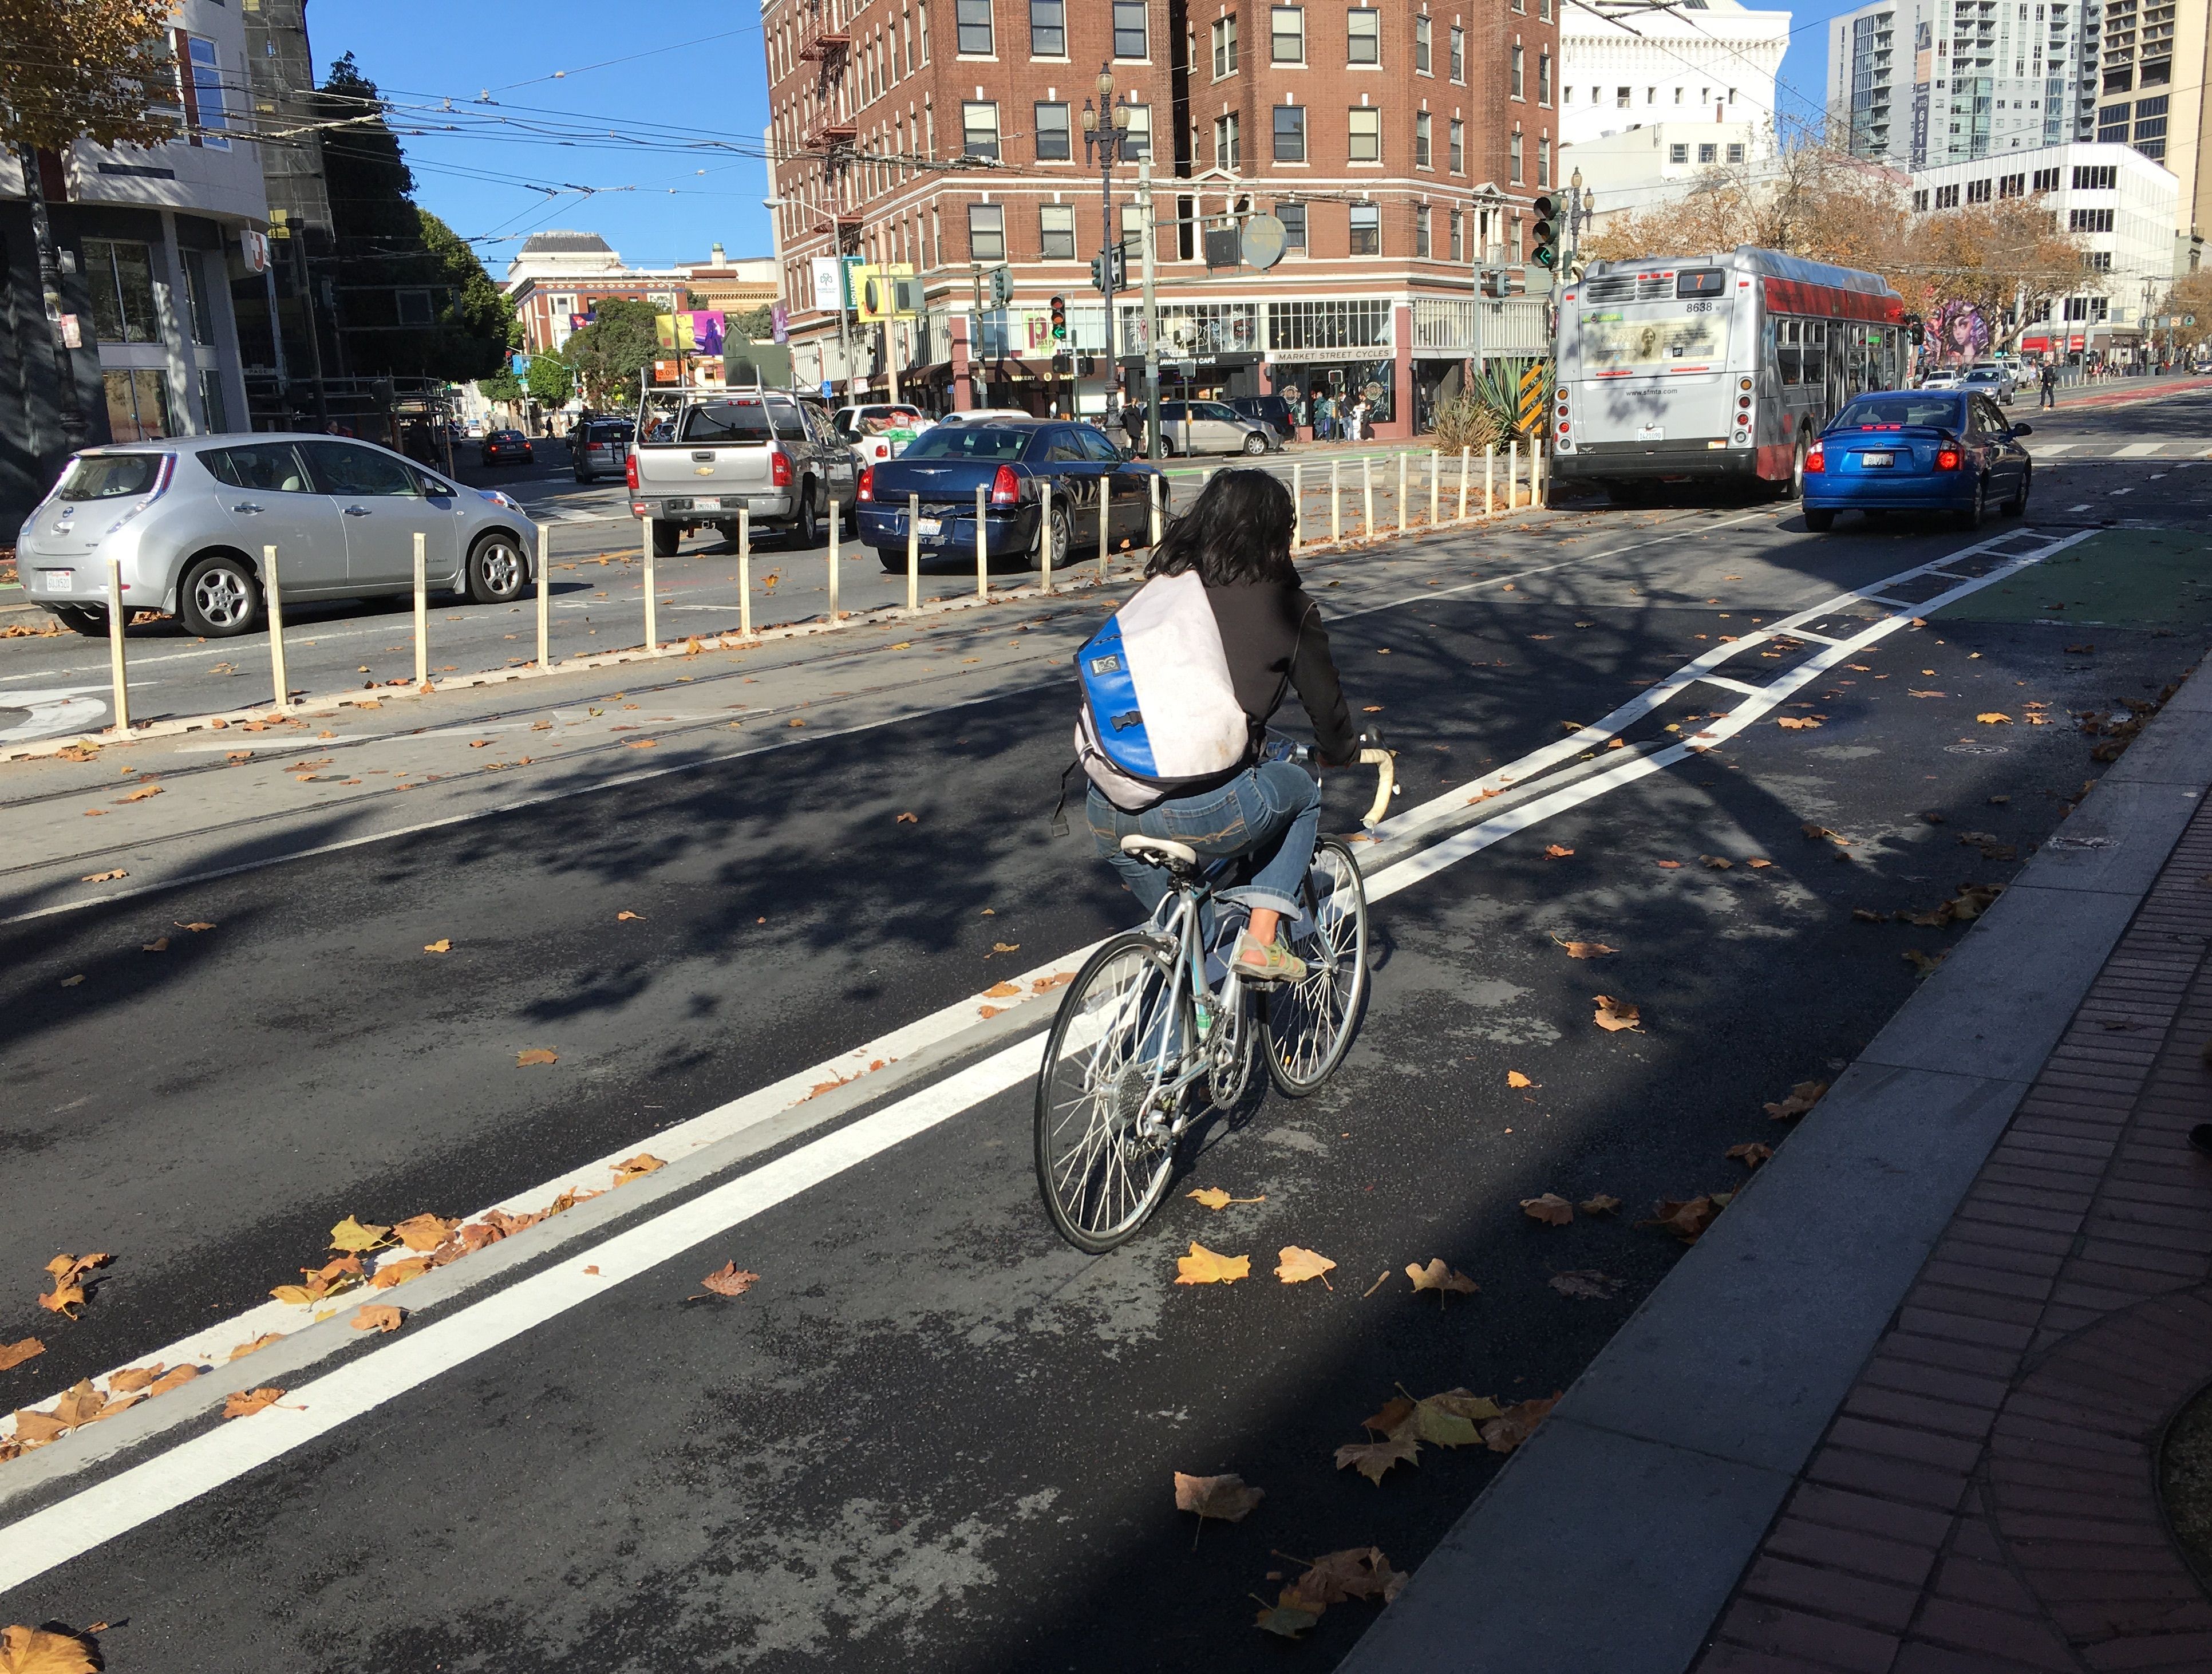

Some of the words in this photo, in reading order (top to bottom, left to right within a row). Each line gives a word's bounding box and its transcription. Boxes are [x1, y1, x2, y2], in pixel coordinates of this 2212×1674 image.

[1917, 98, 1928, 108] 415
[847, 261, 858, 305] INNOVATION
[1694, 274, 1704, 289] 7
[1686, 302, 1712, 313] 8638
[1198, 355, 1216, 364] CAFÉ
[1279, 353, 1316, 361] MARKET
[1356, 350, 1389, 358] CYCLES
[1626, 388, 1678, 397] www.sfmta.com
